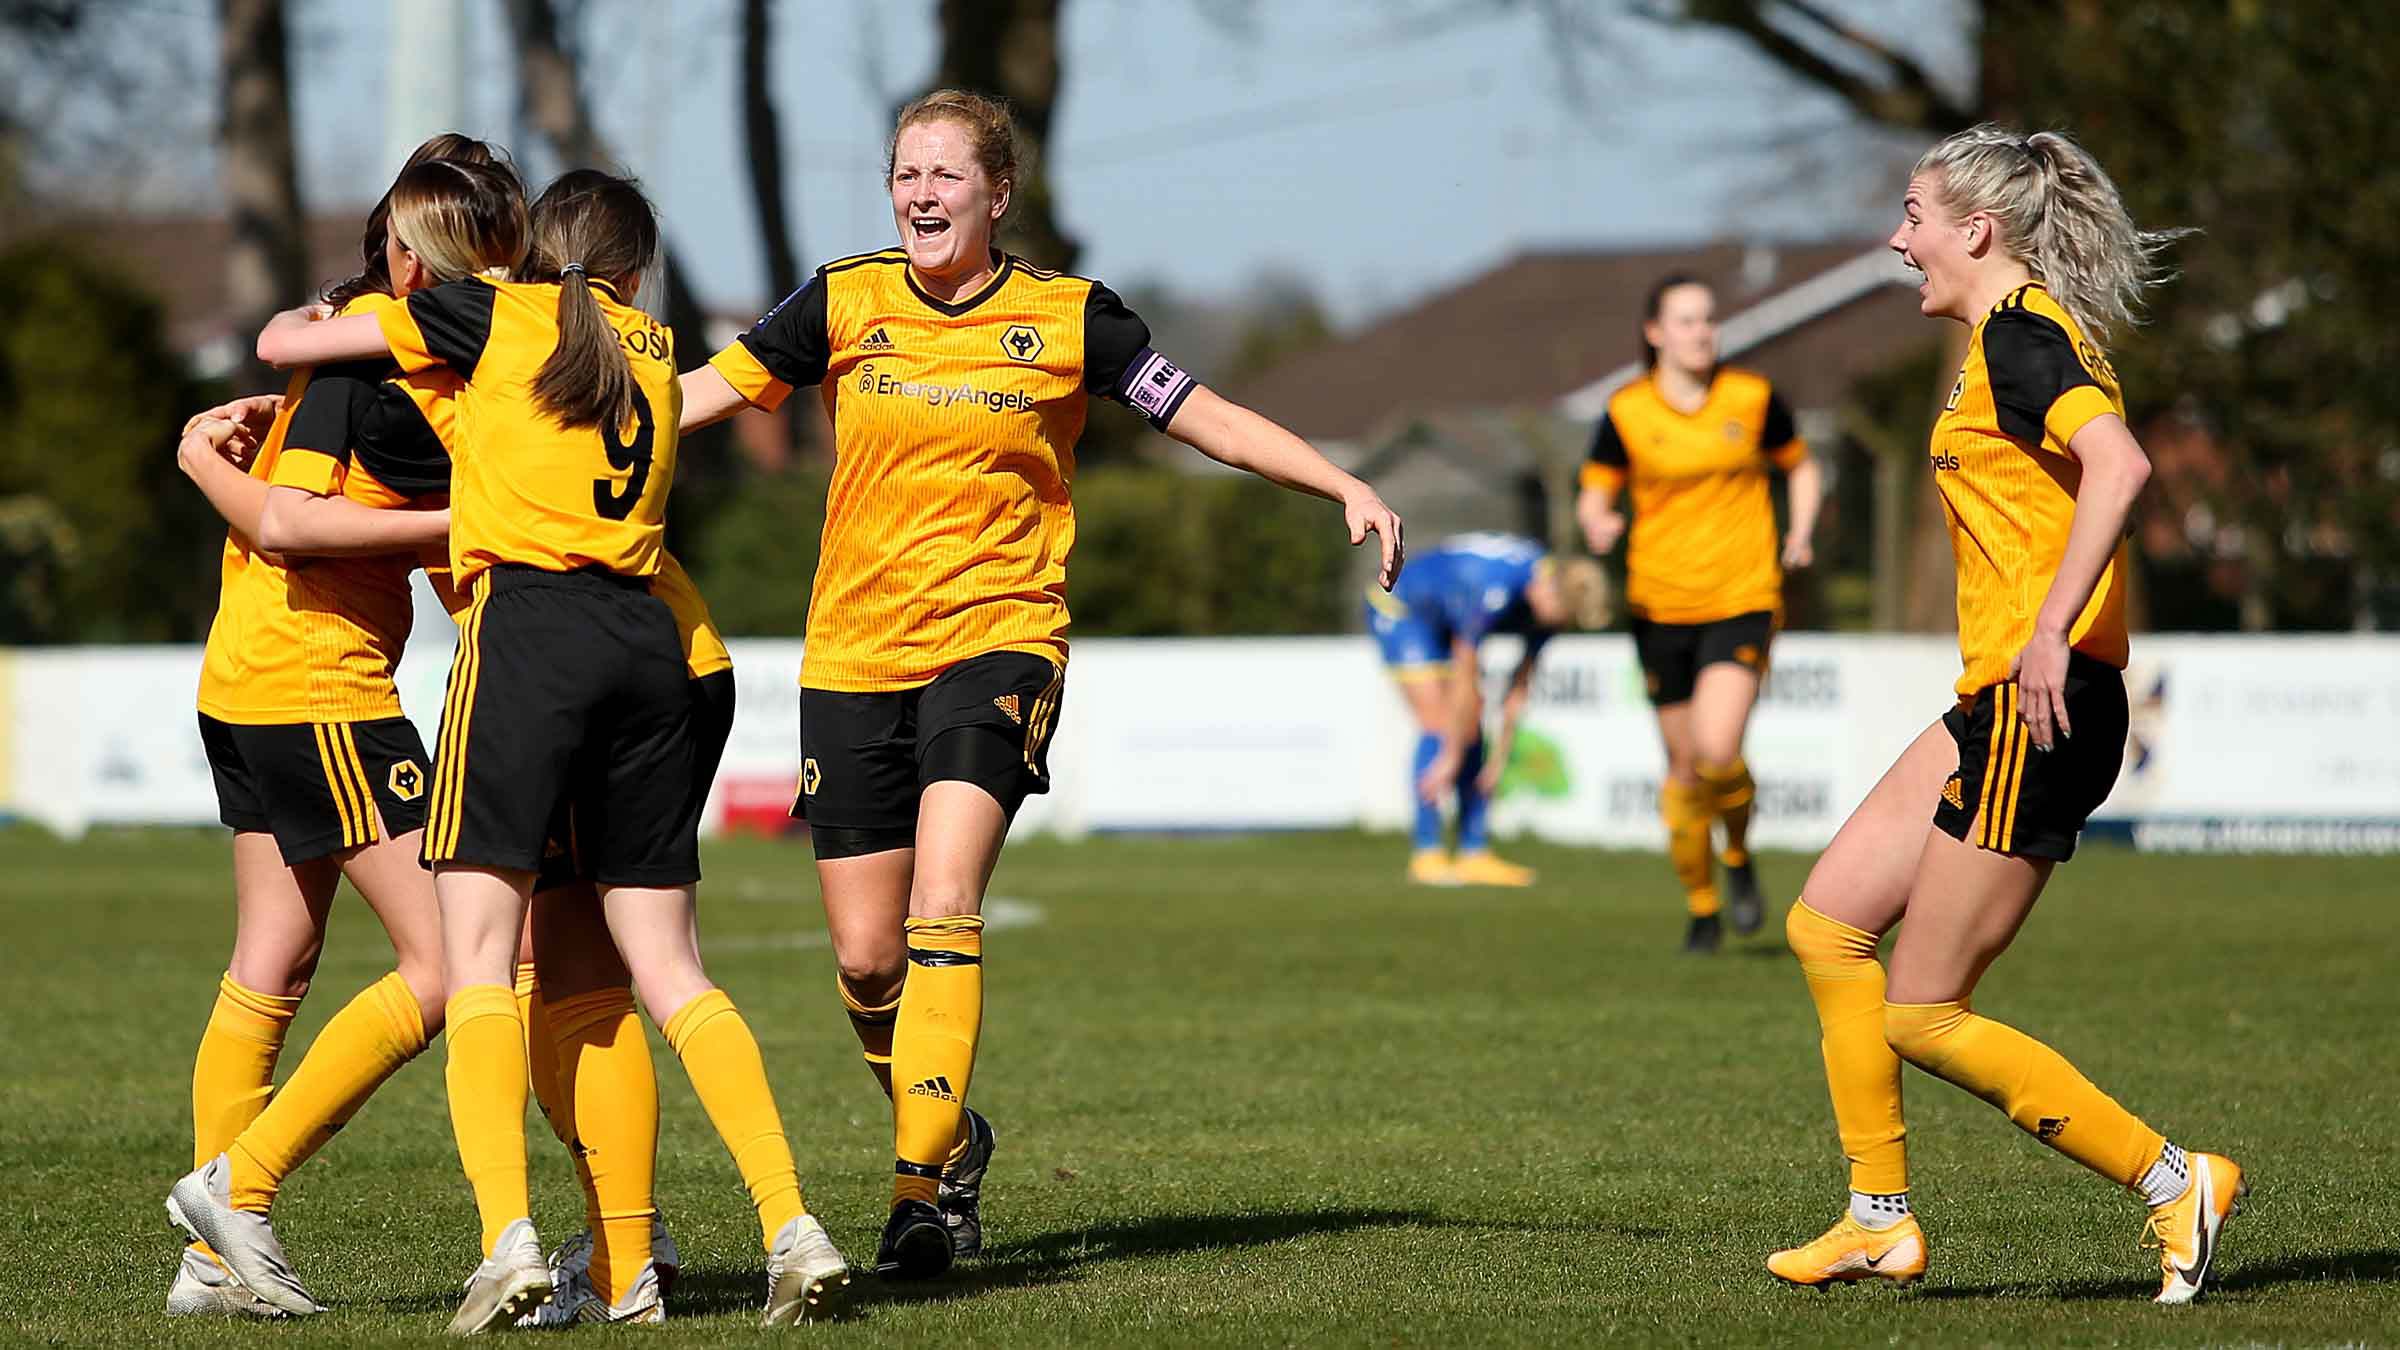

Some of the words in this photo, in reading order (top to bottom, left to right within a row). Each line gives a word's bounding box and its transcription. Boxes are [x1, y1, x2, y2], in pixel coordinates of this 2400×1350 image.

[877, 374, 1034, 413] EnergyAngels
[592, 384, 656, 521] 9
[907, 1086, 958, 1103] adidas
